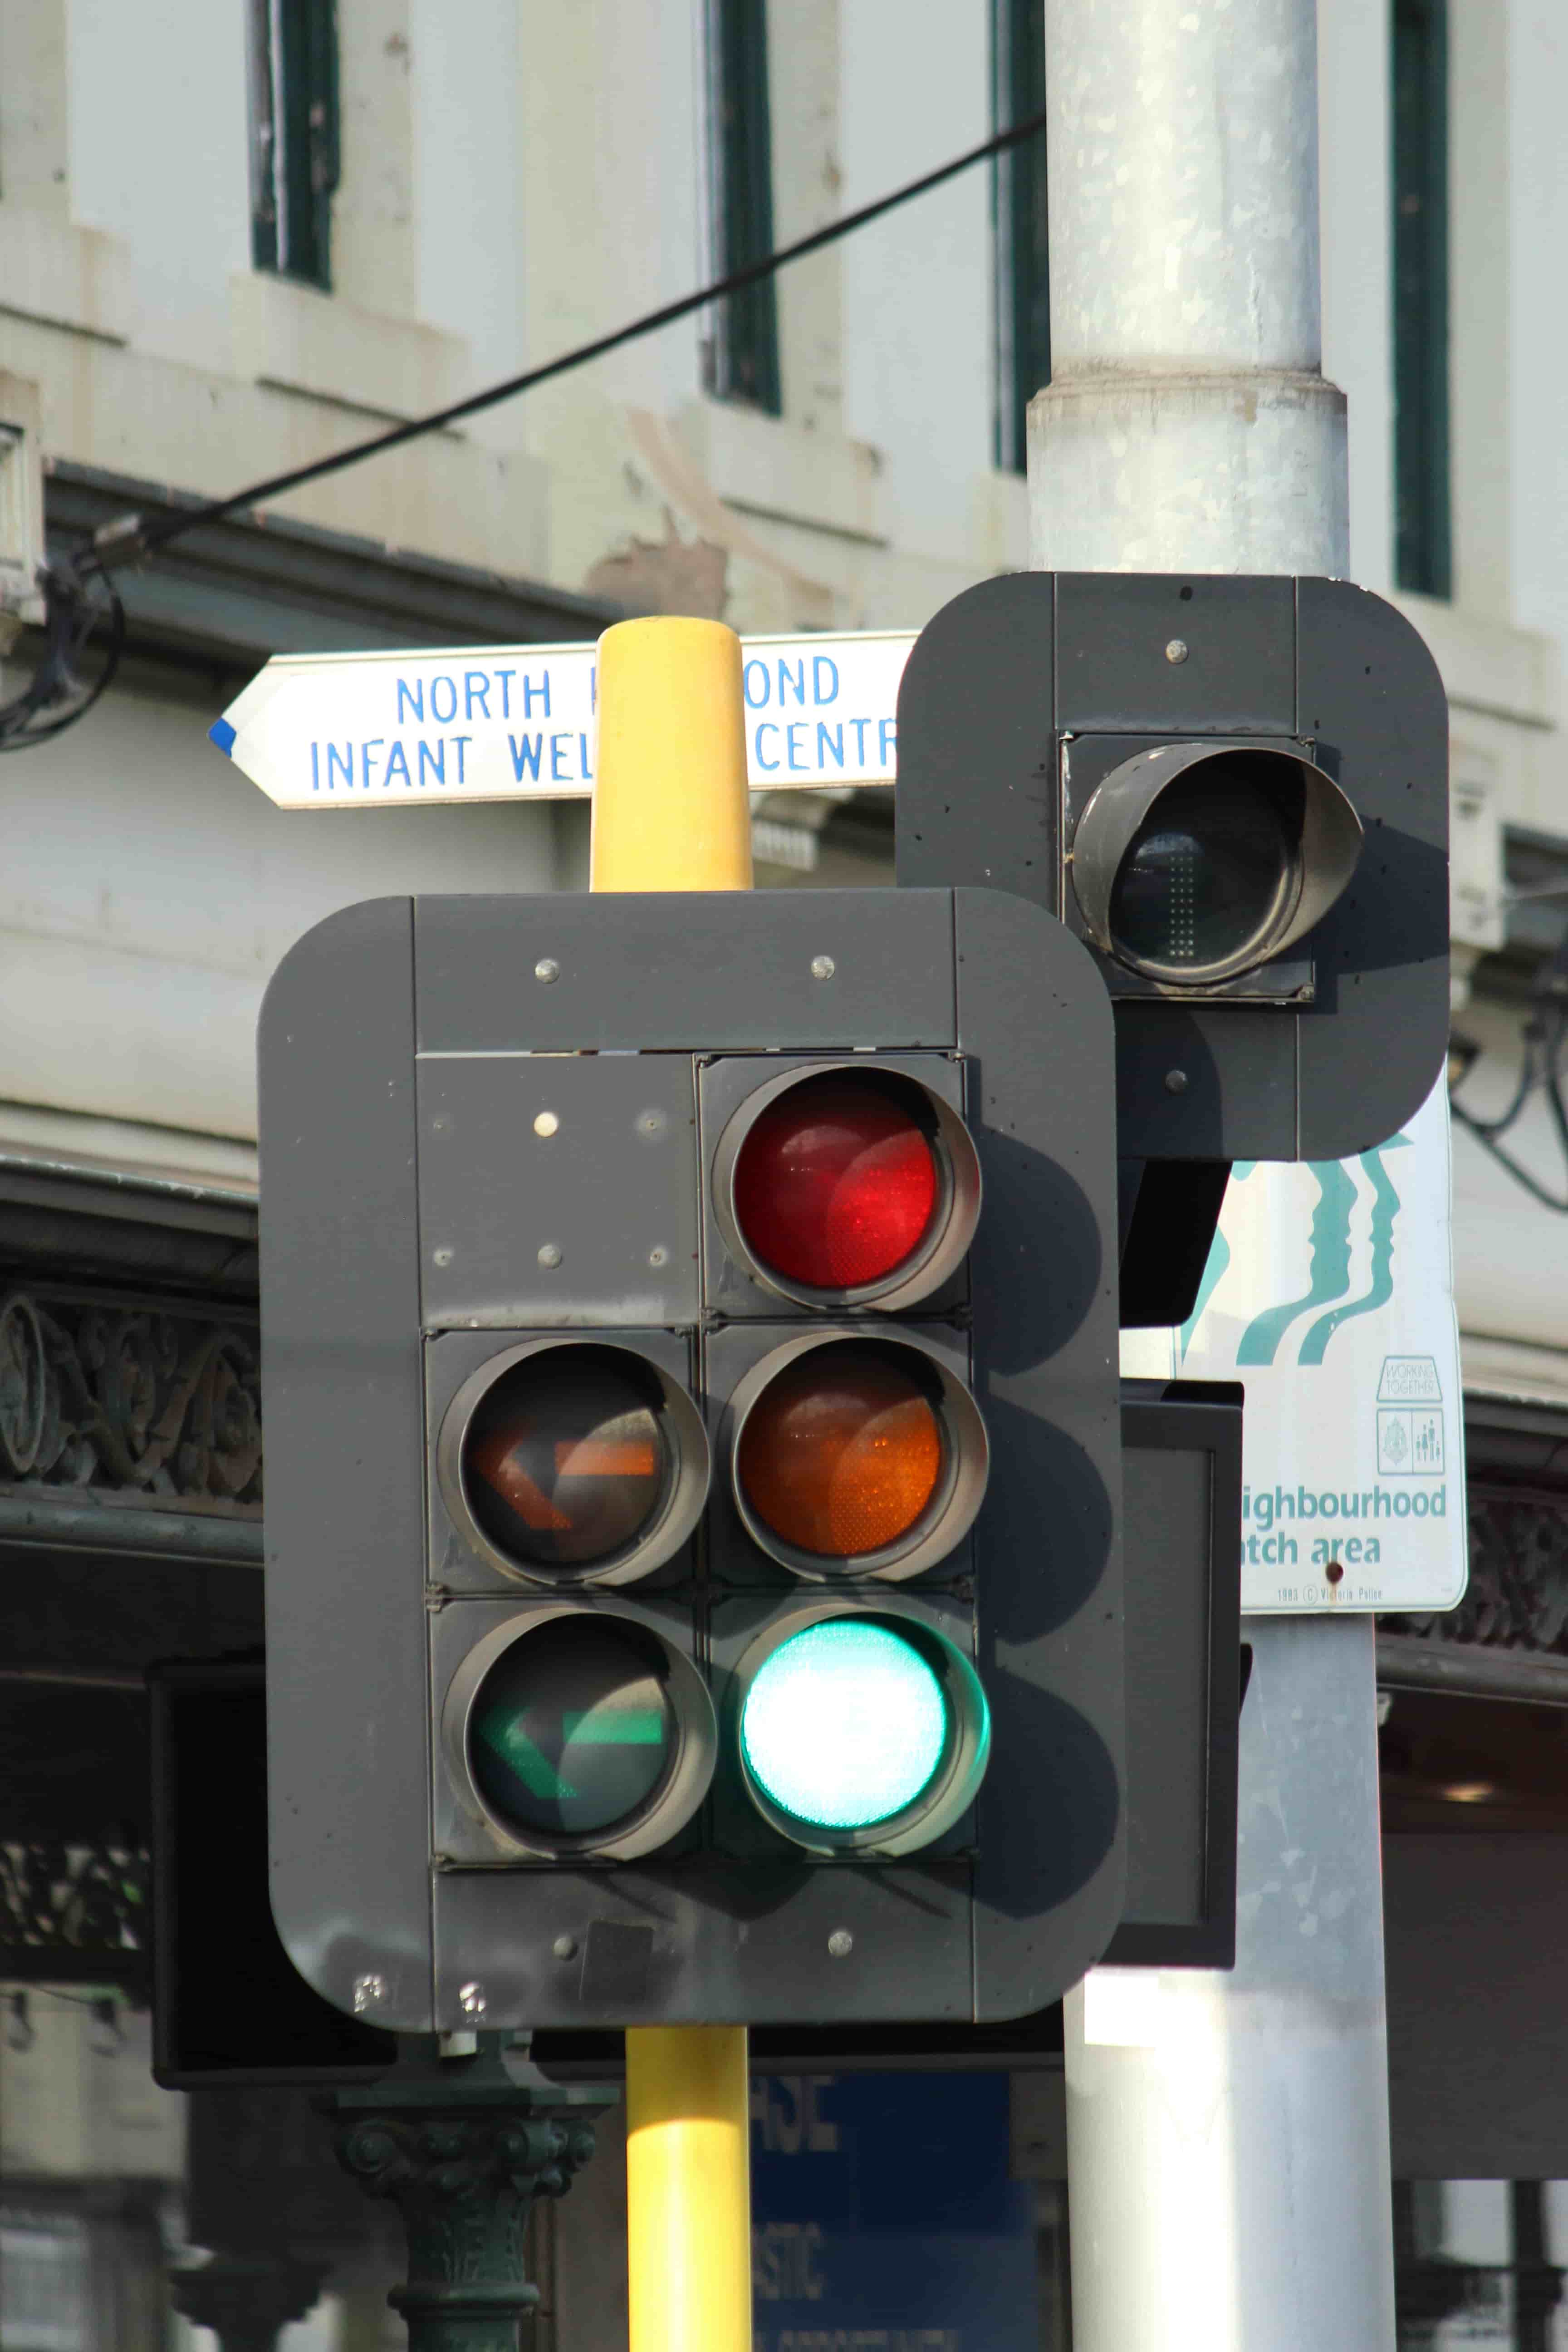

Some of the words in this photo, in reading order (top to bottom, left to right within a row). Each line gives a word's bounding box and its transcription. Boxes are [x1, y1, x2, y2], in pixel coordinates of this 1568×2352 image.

[397, 669, 551, 725] NORTH
[743, 656, 839, 709] OND
[311, 736, 472, 790] INFANT
[508, 732, 593, 782] WEL
[755, 717, 897, 771] CENTR
[1243, 1484, 1446, 1532] ighbourhood
[1241, 1531, 1298, 1566] tch
[1311, 1535, 1381, 1565] area
